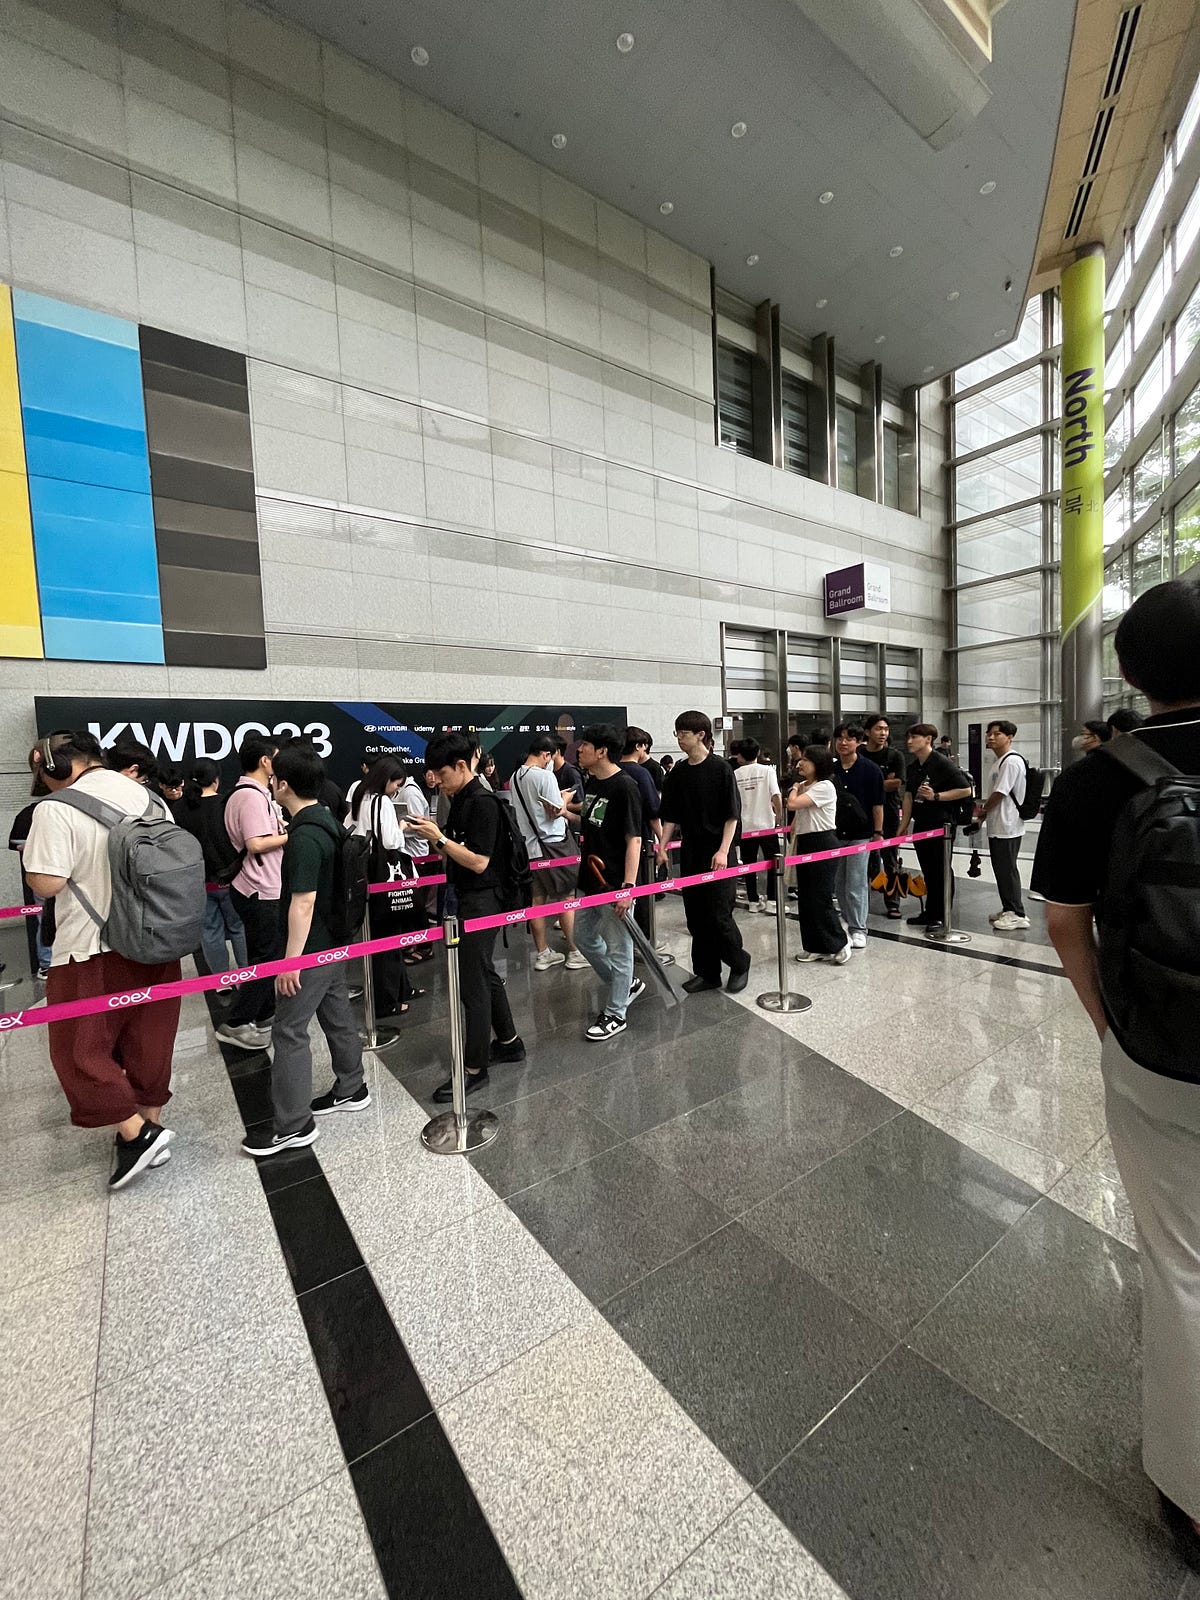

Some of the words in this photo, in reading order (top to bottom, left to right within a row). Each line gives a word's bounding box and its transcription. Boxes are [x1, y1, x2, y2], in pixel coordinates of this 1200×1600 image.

[1065, 368, 1096, 468] North
[829, 585, 852, 599] Grand
[867, 582, 881, 593] Grand
[829, 594, 864, 610] Ballroom
[414, 725, 435, 733] udemy
[379, 745, 412, 754] Together,
[401, 878, 418, 887] coex
[388, 888, 414, 898] FIGHTING
[391, 896, 413, 905] ANIMAL
[506, 909, 526, 921] coex
[564, 898, 582, 910] coex
[615, 889, 631, 899] coex
[390, 902, 414, 911] TESTING
[108, 986, 152, 1008] coex
[220, 965, 258, 985] coex
[317, 946, 350, 964] coex
[400, 929, 428, 946] coex
